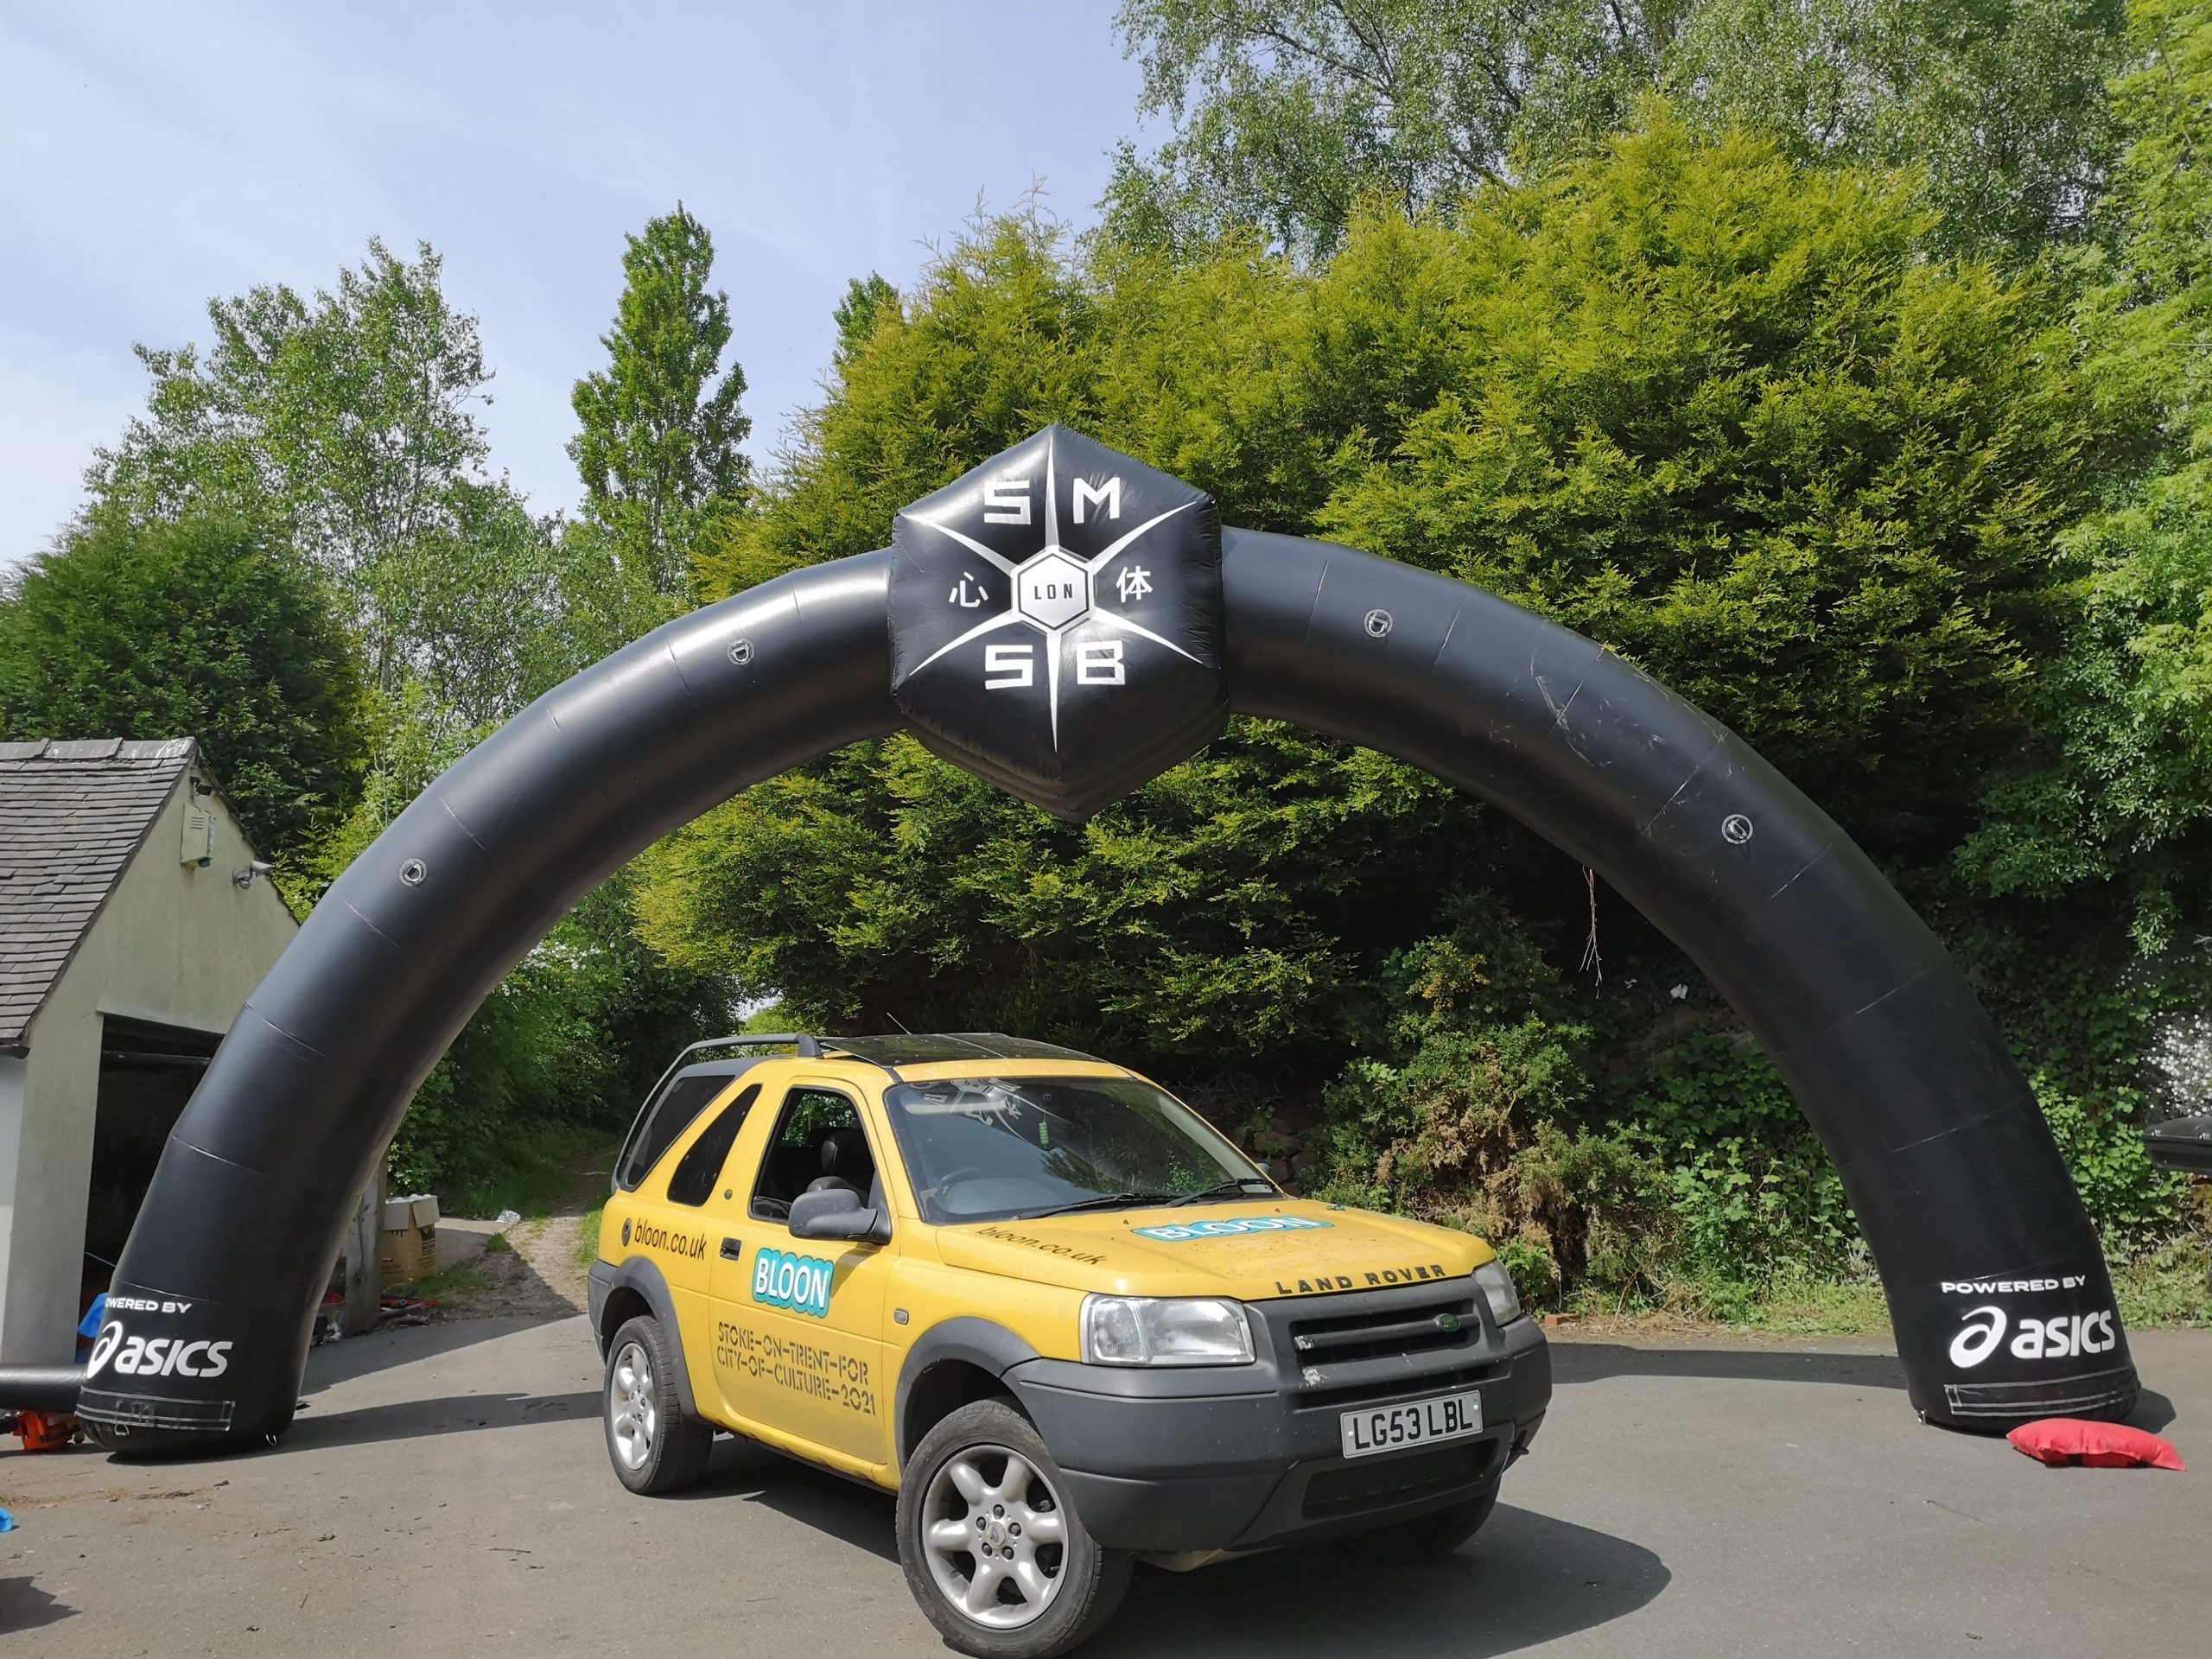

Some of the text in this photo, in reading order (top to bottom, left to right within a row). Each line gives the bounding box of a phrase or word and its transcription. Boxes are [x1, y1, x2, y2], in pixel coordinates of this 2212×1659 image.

[983, 477, 1121, 524] S M
[949, 571, 988, 607] 心
[1033, 582, 1073, 601] LON
[1116, 565, 1153, 602] 体
[984, 639, 1125, 690] S B
[634, 1217, 708, 1261] bloon.co.uk
[976, 1226, 1107, 1265] bloon.co.uk
[1144, 1217, 1321, 1240] BLOON
[755, 1257, 830, 1308] BLOON
[1275, 1264, 1446, 1294] LAND ROVER
[1941, 1274, 2086, 1294] POWERED BY
[105, 1297, 193, 1313] OWERED BY
[718, 1321, 868, 1385] STOKE-ON-TRENT-FOR
[716, 1345, 876, 1416] CITY-OF-CULTURE-2021
[1353, 1398, 1473, 1450] LG53 LBL
